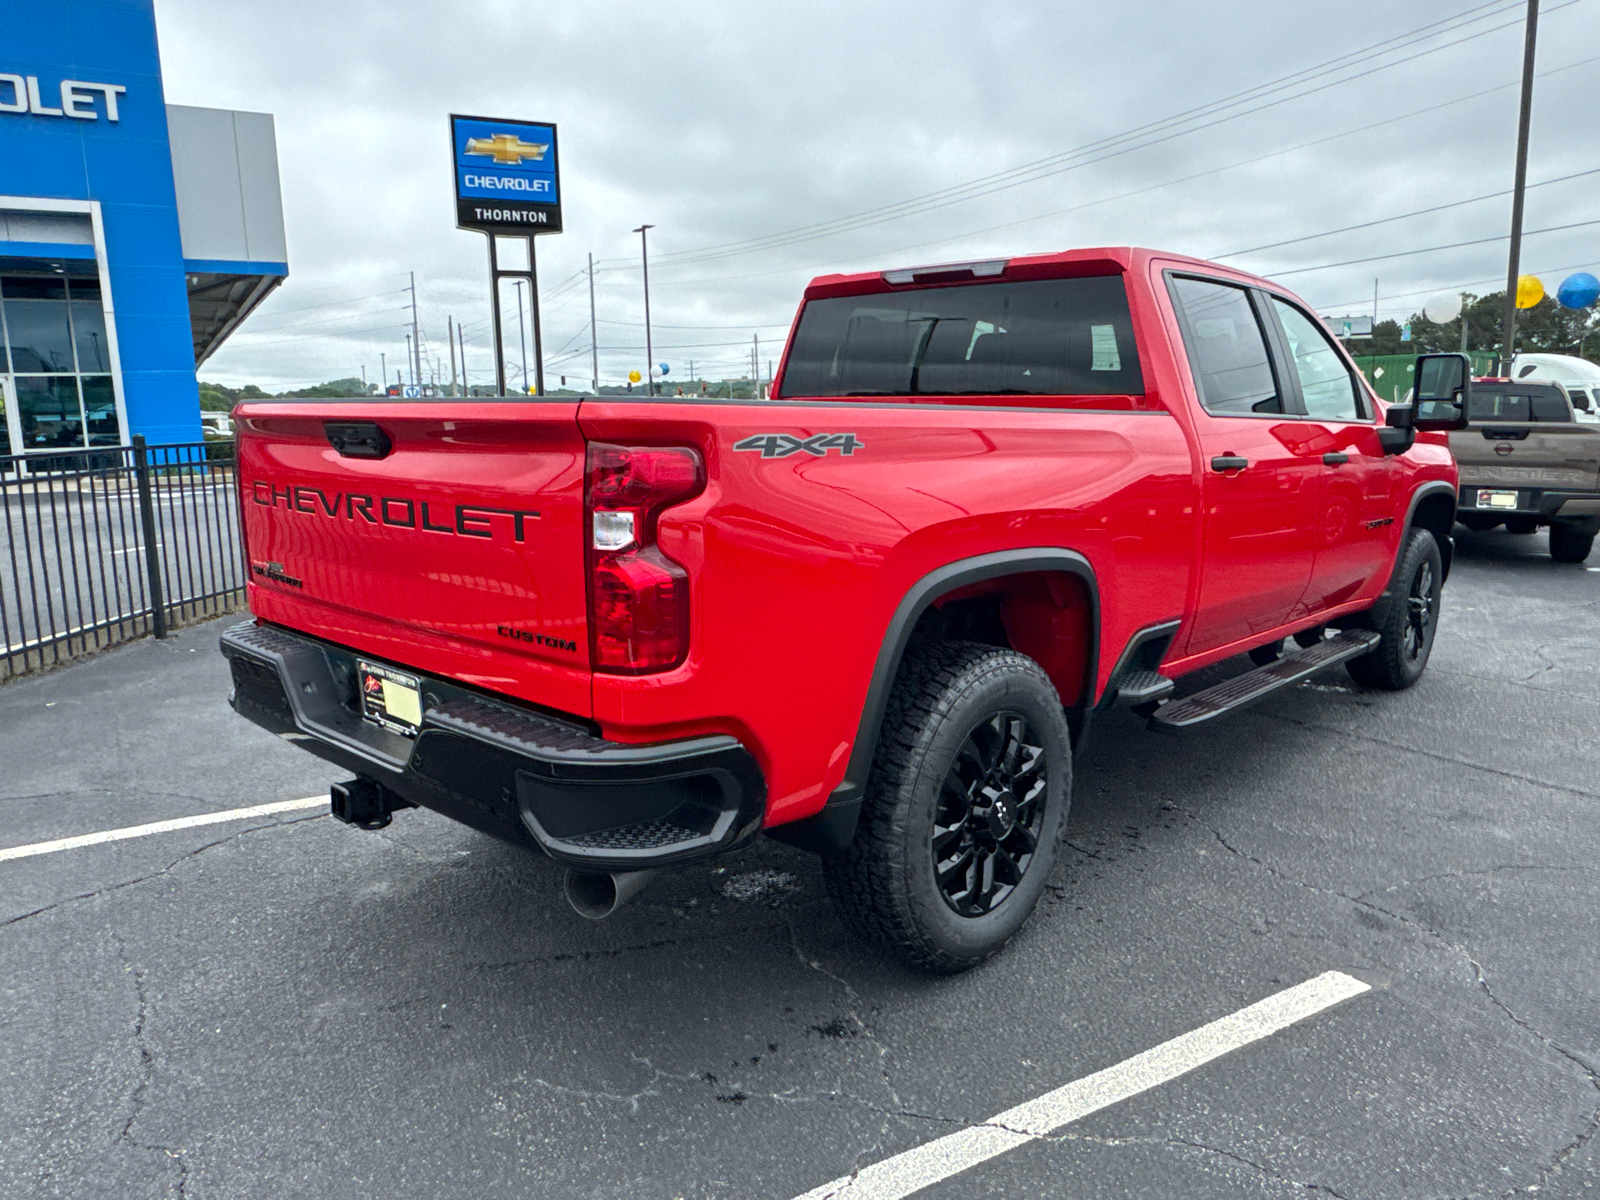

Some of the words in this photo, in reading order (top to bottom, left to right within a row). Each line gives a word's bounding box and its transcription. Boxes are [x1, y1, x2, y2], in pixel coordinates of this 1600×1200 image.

[464, 174, 551, 192] CHEVROLET
[474, 208, 548, 223] THORNTON
[252, 481, 541, 544] CHEVROLET
[497, 625, 576, 651] CUSTOM
